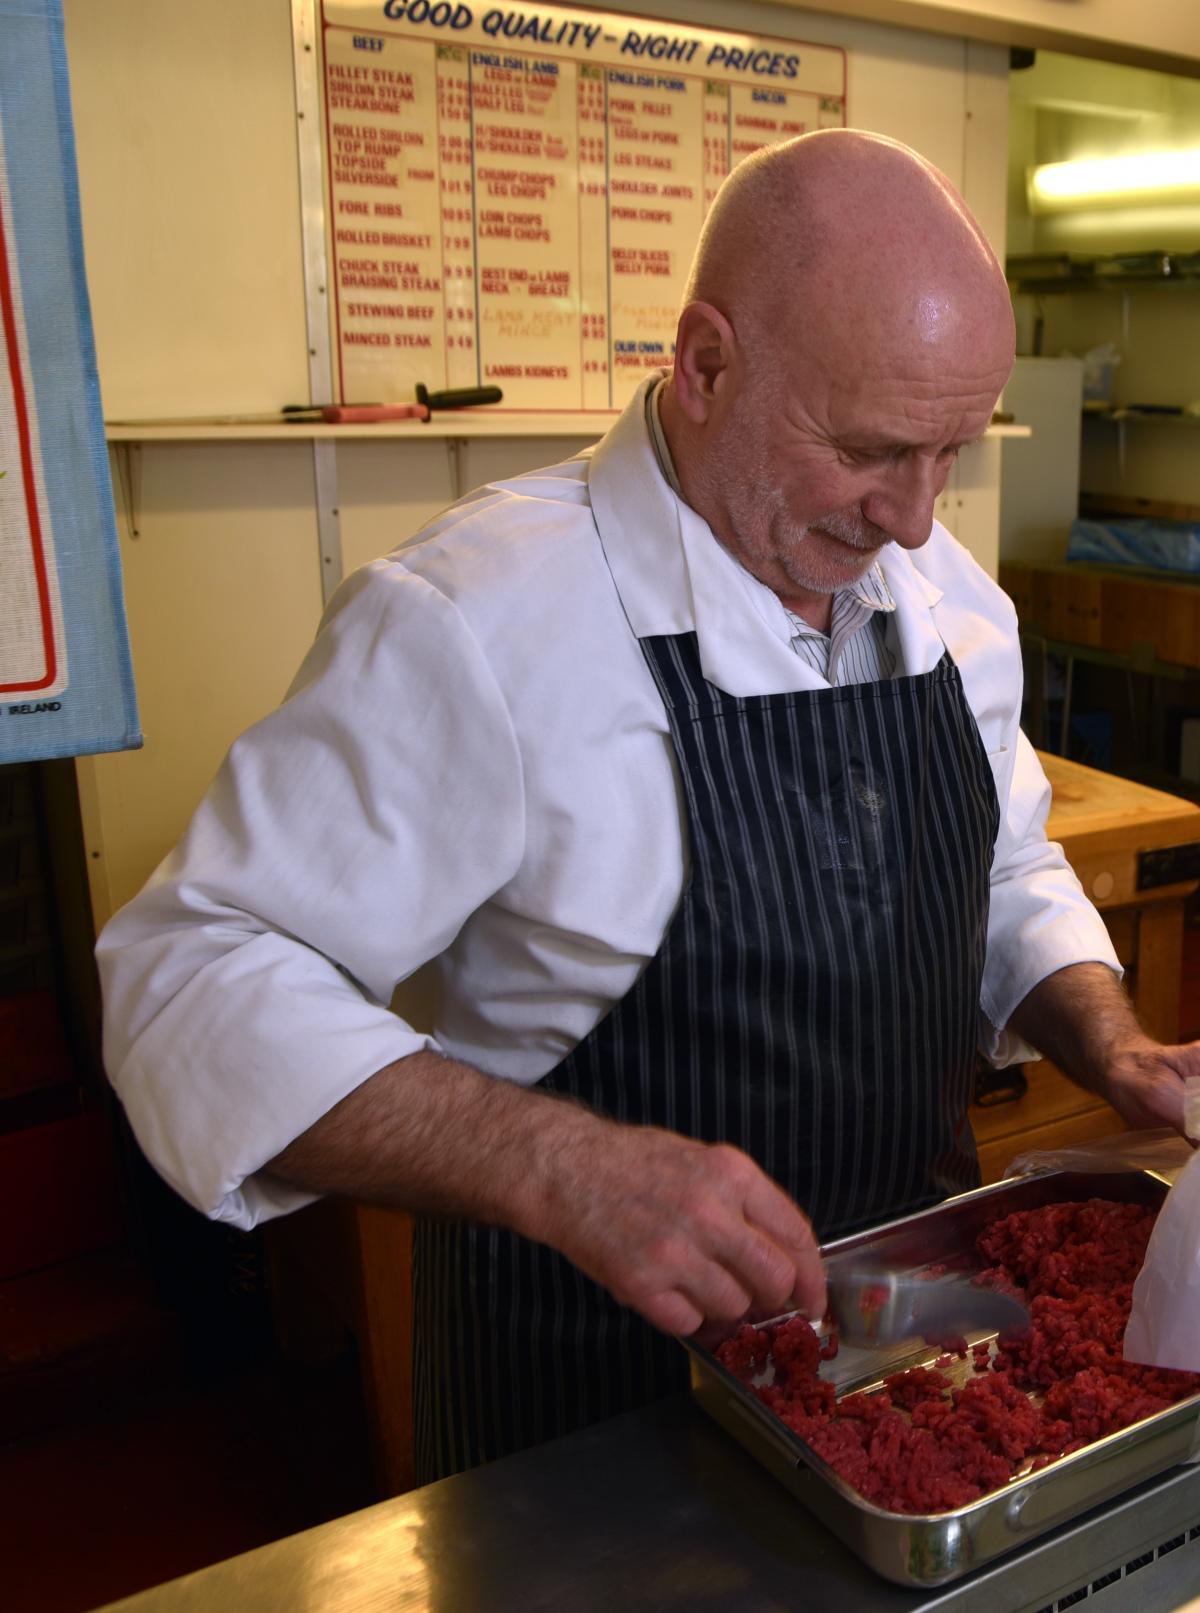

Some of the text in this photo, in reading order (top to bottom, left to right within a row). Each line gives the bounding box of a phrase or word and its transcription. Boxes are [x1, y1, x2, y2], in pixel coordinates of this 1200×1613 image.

[352, 35, 384, 52] BEEF
[384, 0, 472, 29] GOOD
[482, 9, 601, 49] QUALITY
[621, 32, 703, 63] RIGHT
[706, 45, 800, 79] PRICES
[472, 52, 523, 70] ENGLISH
[525, 59, 559, 75] LAMB
[328, 64, 369, 79] FILLET
[372, 69, 413, 85] STEAK
[609, 69, 654, 88] ENGLISH
[330, 80, 375, 95] SIRLOIN
[379, 86, 415, 101] STEAK
[333, 123, 377, 140] ROLLED
[380, 128, 424, 146] SIRLOIN
[336, 140, 361, 153] TOP
[364, 142, 401, 158] RUMP
[335, 154, 386, 170] TOPSIDE
[335, 169, 399, 188] SILVERSIDE
[477, 168, 555, 187] CHUMP CHOPS
[488, 182, 508, 196] LEG
[511, 184, 546, 199] CHOPS
[338, 200, 369, 216] FORE
[374, 202, 403, 218] RIBS
[480, 210, 543, 226] LOIN CHOPS
[336, 230, 380, 245] ROLLED
[382, 233, 432, 249] BRISKET
[479, 224, 551, 243] LAMB CHOPS
[339, 258, 419, 275] CHUCK STEAK
[481, 267, 506, 280] BEST
[539, 271, 570, 283] LAMB
[341, 273, 398, 290] BRAISING
[401, 276, 441, 291] STEAK
[527, 283, 569, 296] BREAST
[348, 303, 404, 319] STEWING
[407, 305, 434, 320] BEEF
[343, 332, 391, 346] MINCED
[394, 334, 432, 348] STEAK
[484, 365, 522, 378] LAMBS
[525, 366, 569, 379] KIDNEYS
[9, 702, 62, 715] IRELAND
